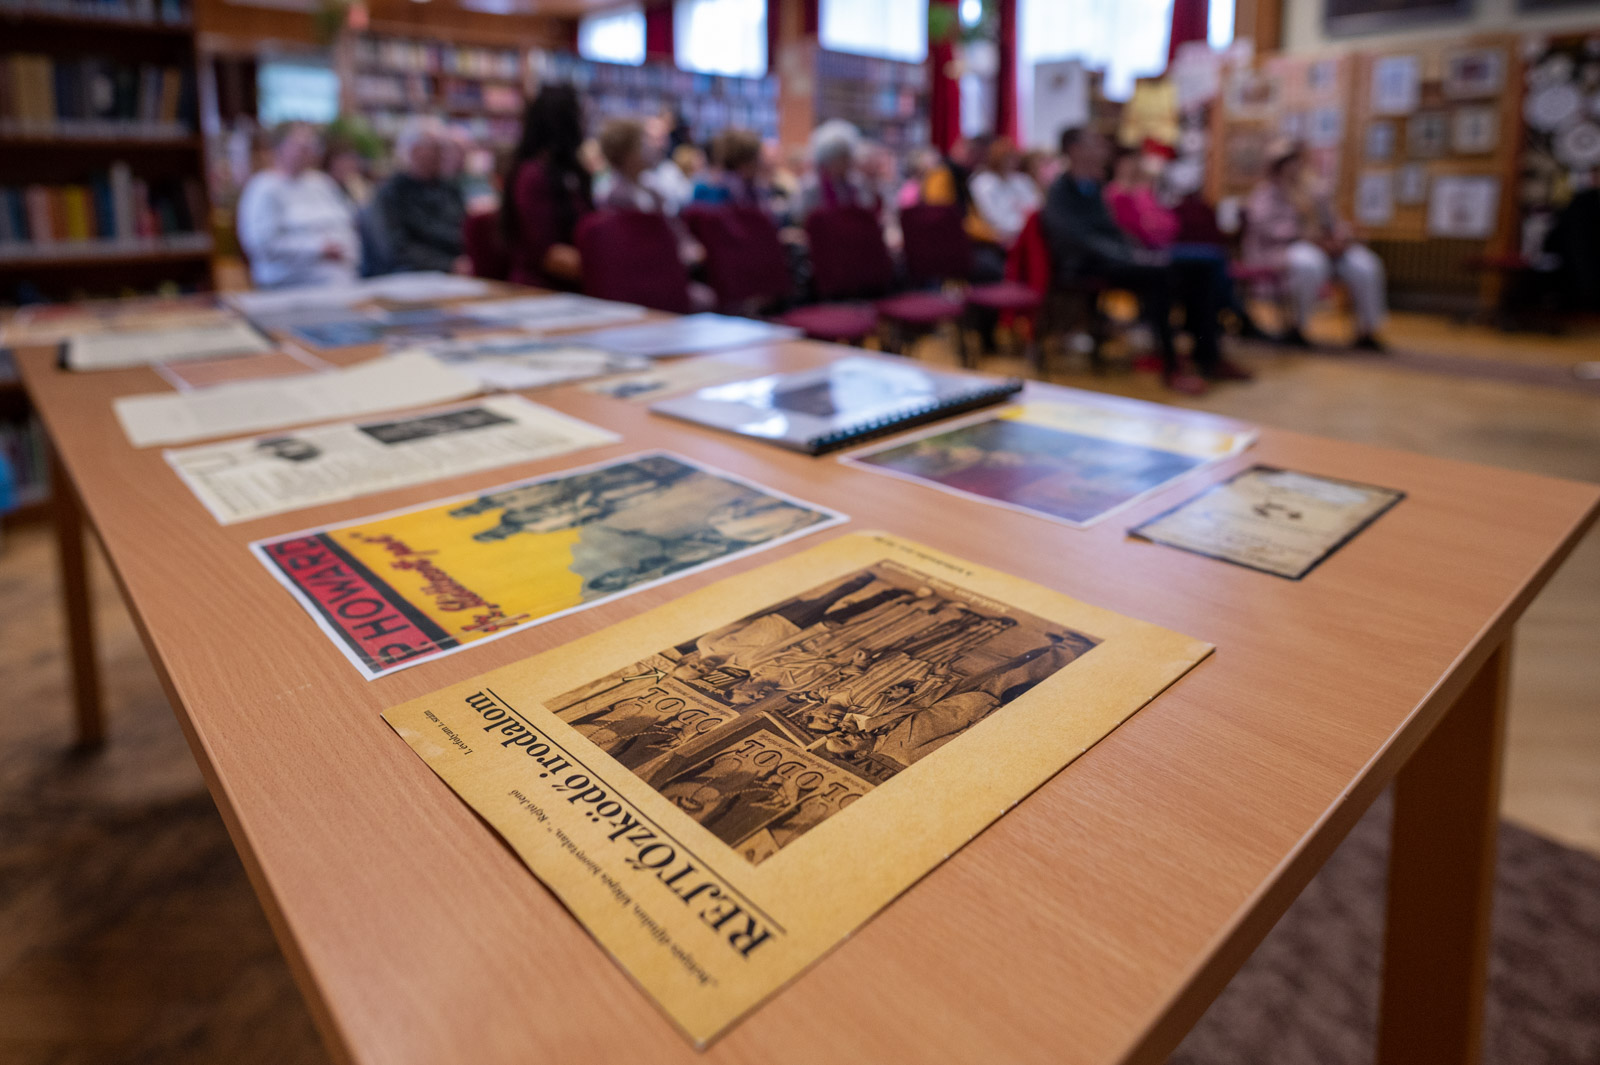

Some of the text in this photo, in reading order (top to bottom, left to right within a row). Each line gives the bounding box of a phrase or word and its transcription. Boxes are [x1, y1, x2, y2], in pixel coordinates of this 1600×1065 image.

[274, 540, 409, 638] HOWARD
[508, 790, 530, 804] Jenő
[734, 738, 825, 790] ODOL
[465, 691, 773, 959] REJTŐzködő irodalom
